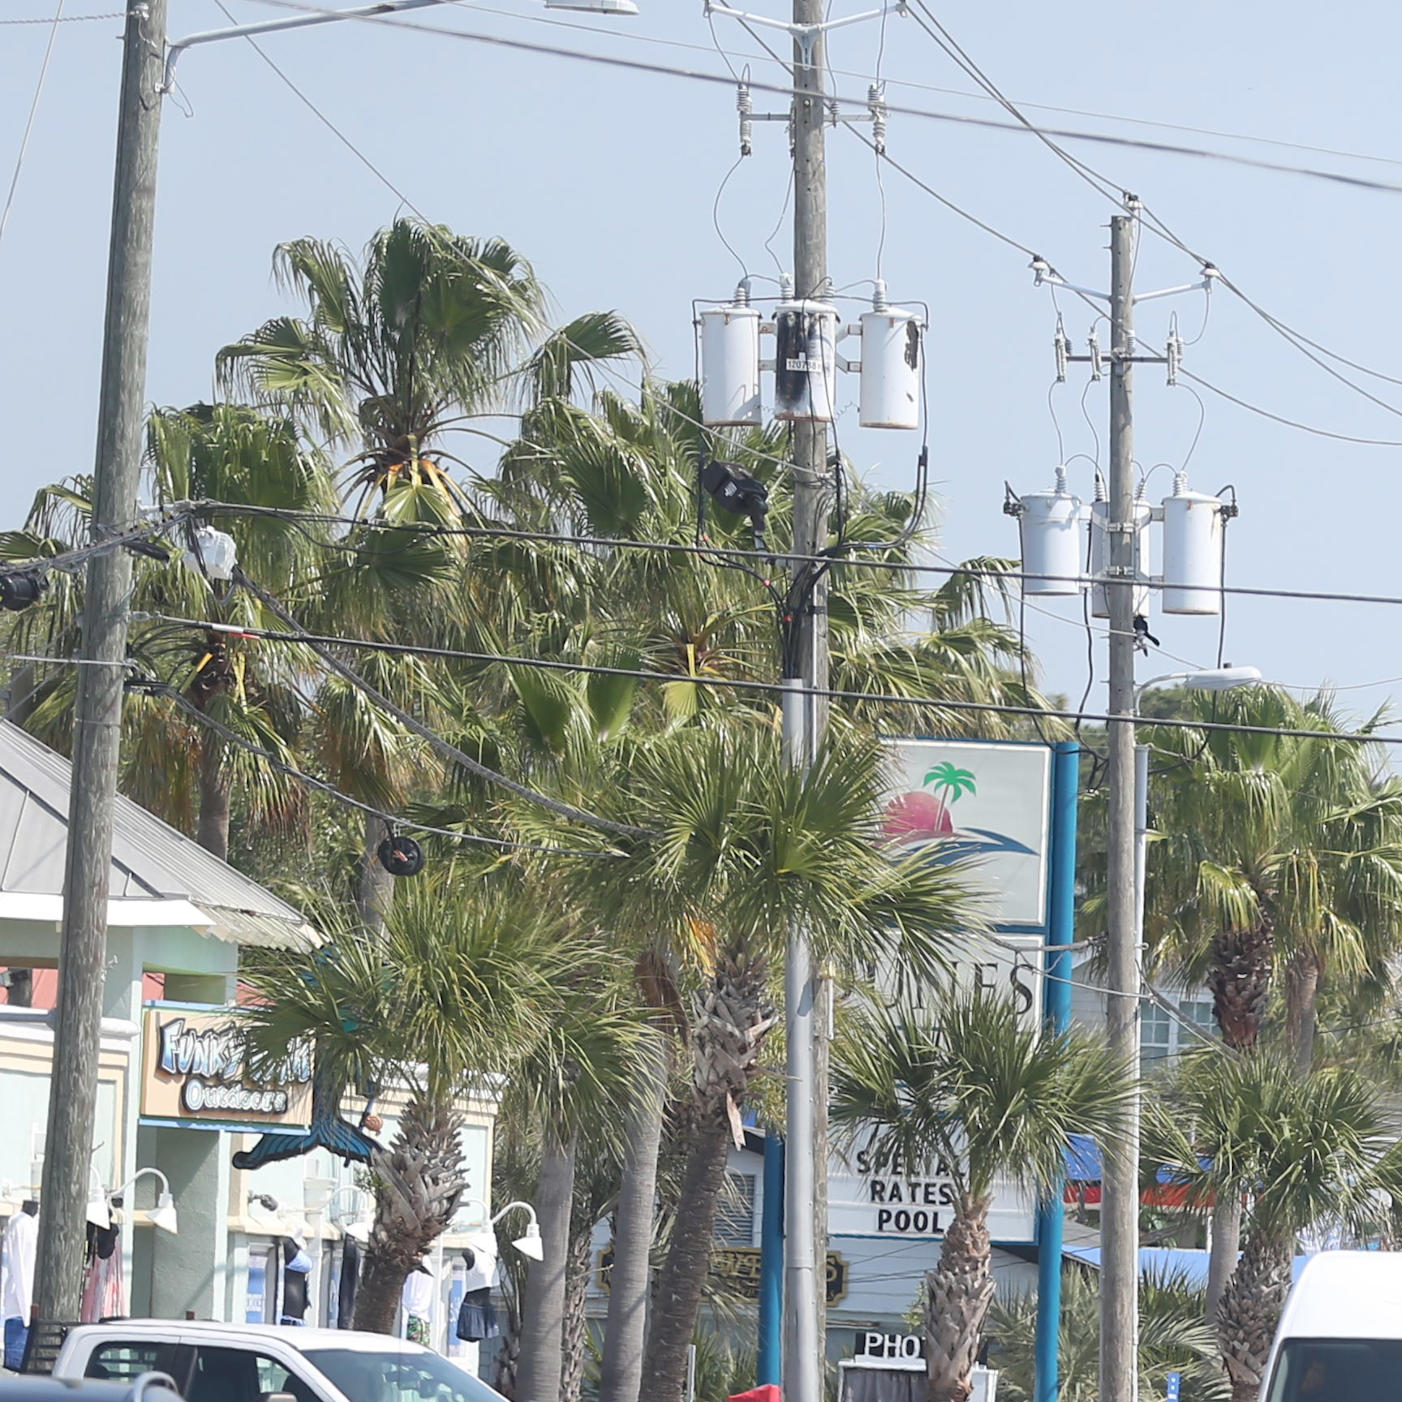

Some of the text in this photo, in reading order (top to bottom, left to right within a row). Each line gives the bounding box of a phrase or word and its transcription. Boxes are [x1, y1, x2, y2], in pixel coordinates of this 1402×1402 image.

[871, 1180, 951, 1204] RATES
[878, 1209, 944, 1232] POOL
[864, 1332, 926, 1359] PHO
